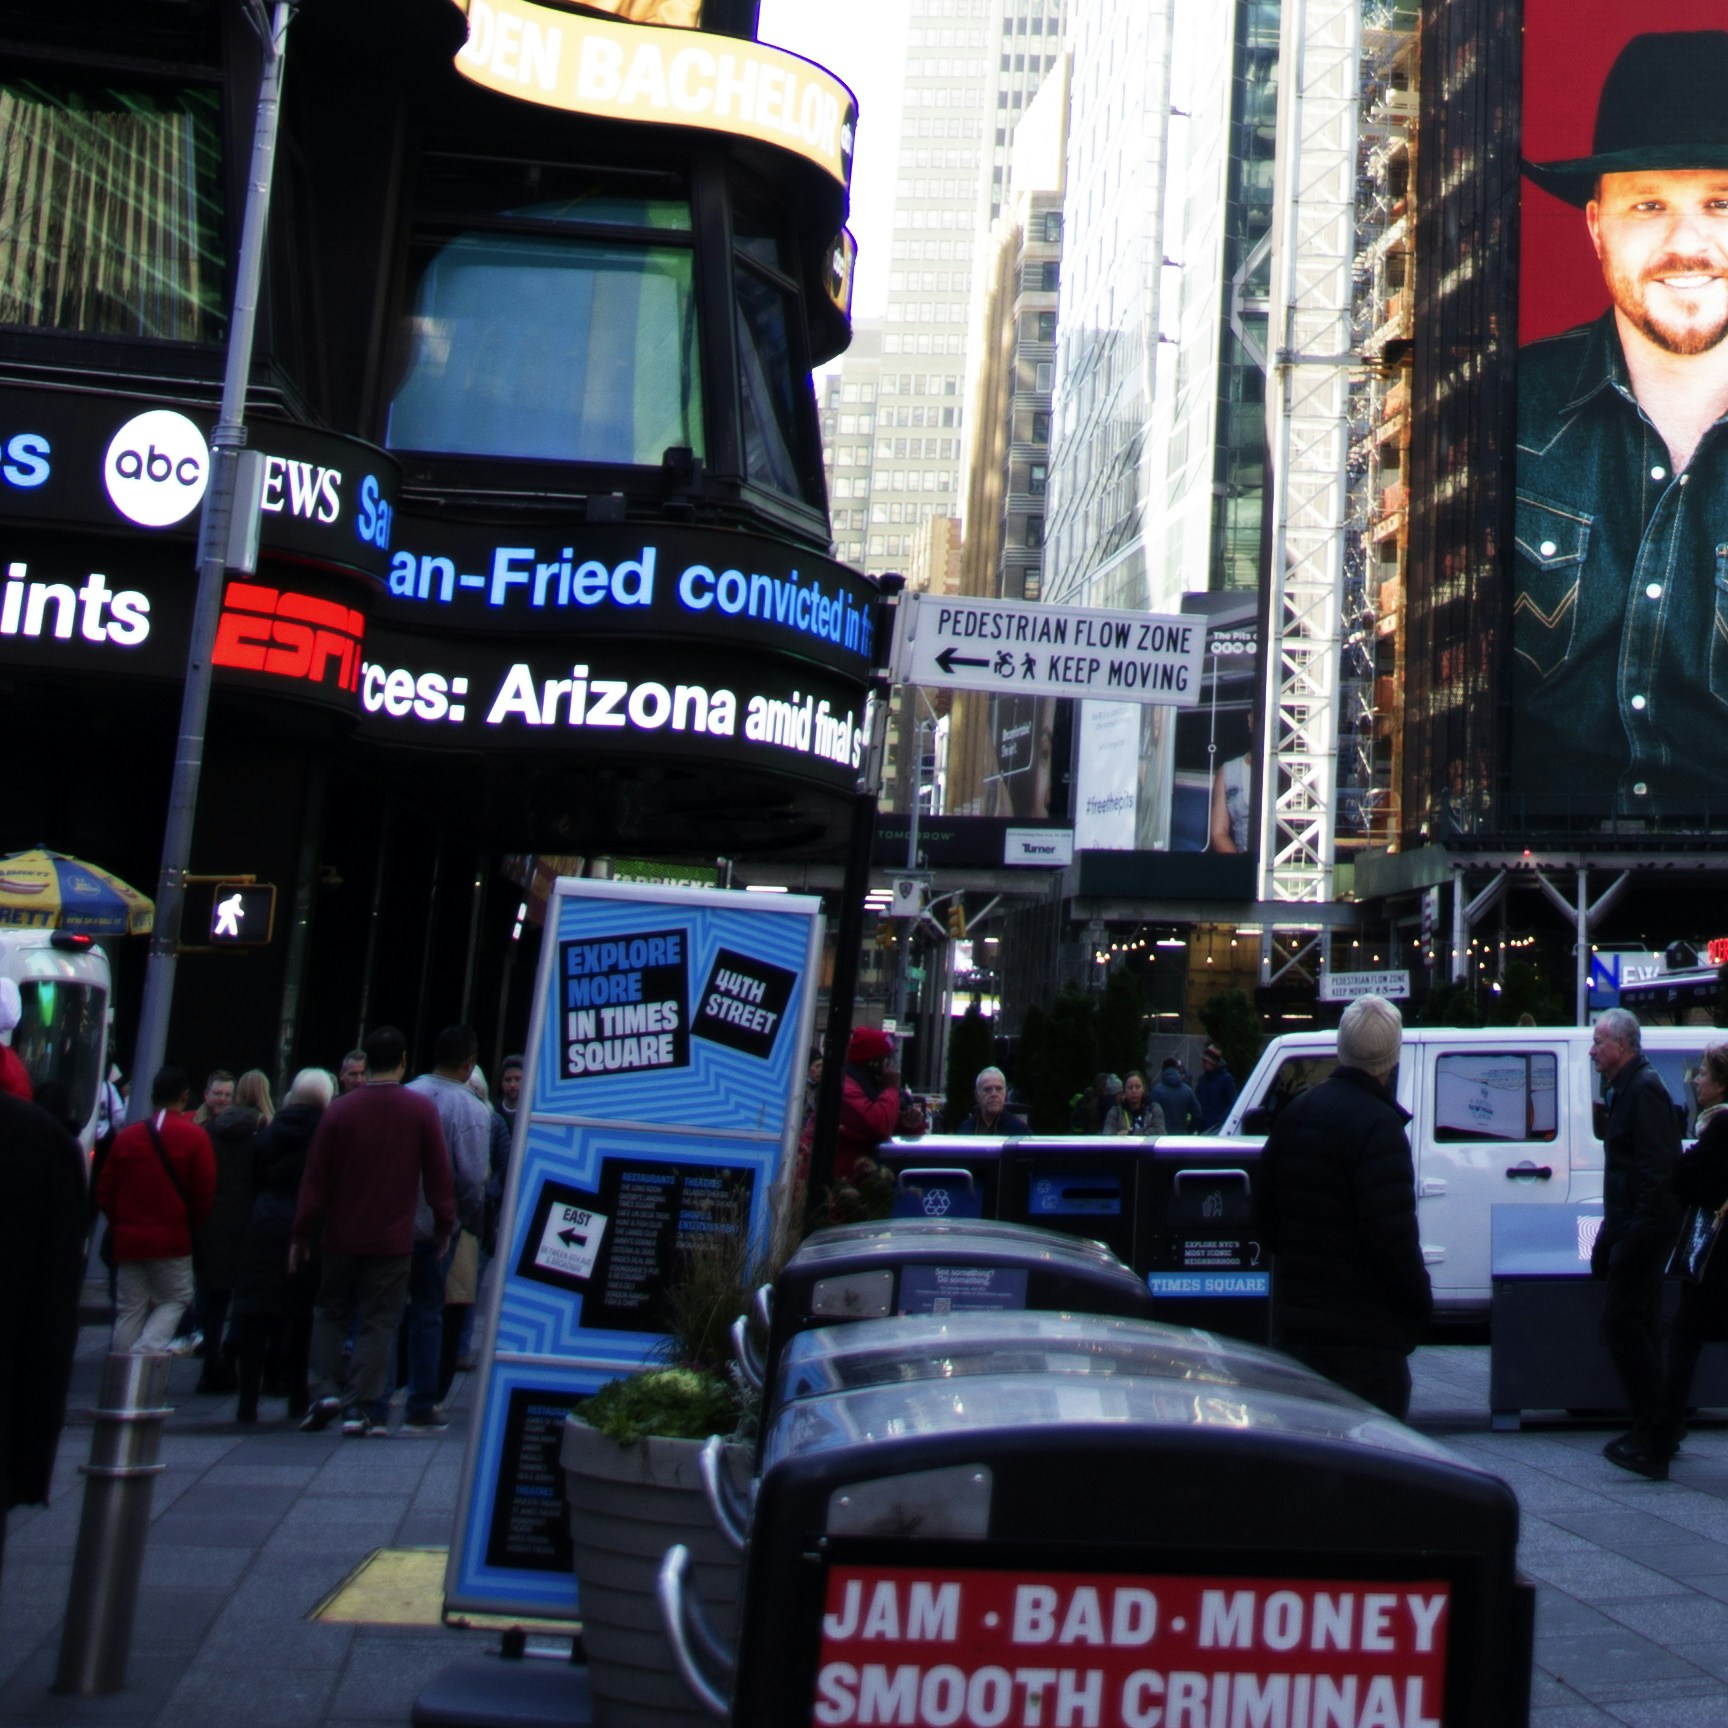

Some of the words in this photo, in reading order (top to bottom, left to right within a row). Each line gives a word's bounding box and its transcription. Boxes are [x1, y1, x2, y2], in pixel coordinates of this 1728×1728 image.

[577, 33, 839, 158] BACHELOR
[115, 444, 200, 486] abc
[262, 455, 342, 523] EWS
[679, 563, 843, 643] convicted
[937, 608, 1068, 645] PEDESTRIAN
[1074, 619, 1131, 649] FLOW
[1137, 624, 1192, 654] ZONE
[1048, 654, 1101, 685] KEEP
[1107, 660, 1189, 692] MOVING
[362, 661, 468, 722] ces:
[486, 662, 736, 736] Arizona
[745, 691, 814, 752] amid
[814, 699, 854, 765] final
[1022, 842, 1056, 854] Turner
[567, 935, 681, 976] EXPLORE
[567, 971, 643, 1008] MORE
[714, 968, 767, 1005] 44TH
[1332, 976, 1369, 985] PEDESTRIAN
[1371, 974, 1388, 984] FLOW
[1389, 973, 1406, 983] ZONE
[1332, 986, 1347, 996] KEEP
[567, 1008, 596, 1042] IN
[599, 1000, 679, 1036] TIMES
[705, 994, 778, 1035] STREET
[567, 1034, 675, 1075] SQUARE
[562, 1207, 592, 1227] EAST
[1184, 1240, 1217, 1248] EXPLORE
[934, 1267, 949, 1276] See
[1151, 1278, 1201, 1292] TIMES
[1204, 1278, 1266, 1293] SQUARE
[822, 1579, 962, 1641] JAM
[1011, 1583, 1159, 1647] BAD
[1198, 1589, 1449, 1653] MONEY
[814, 1660, 1103, 1727] SMOOTH
[1120, 1668, 1441, 1728] CRIMINAL
